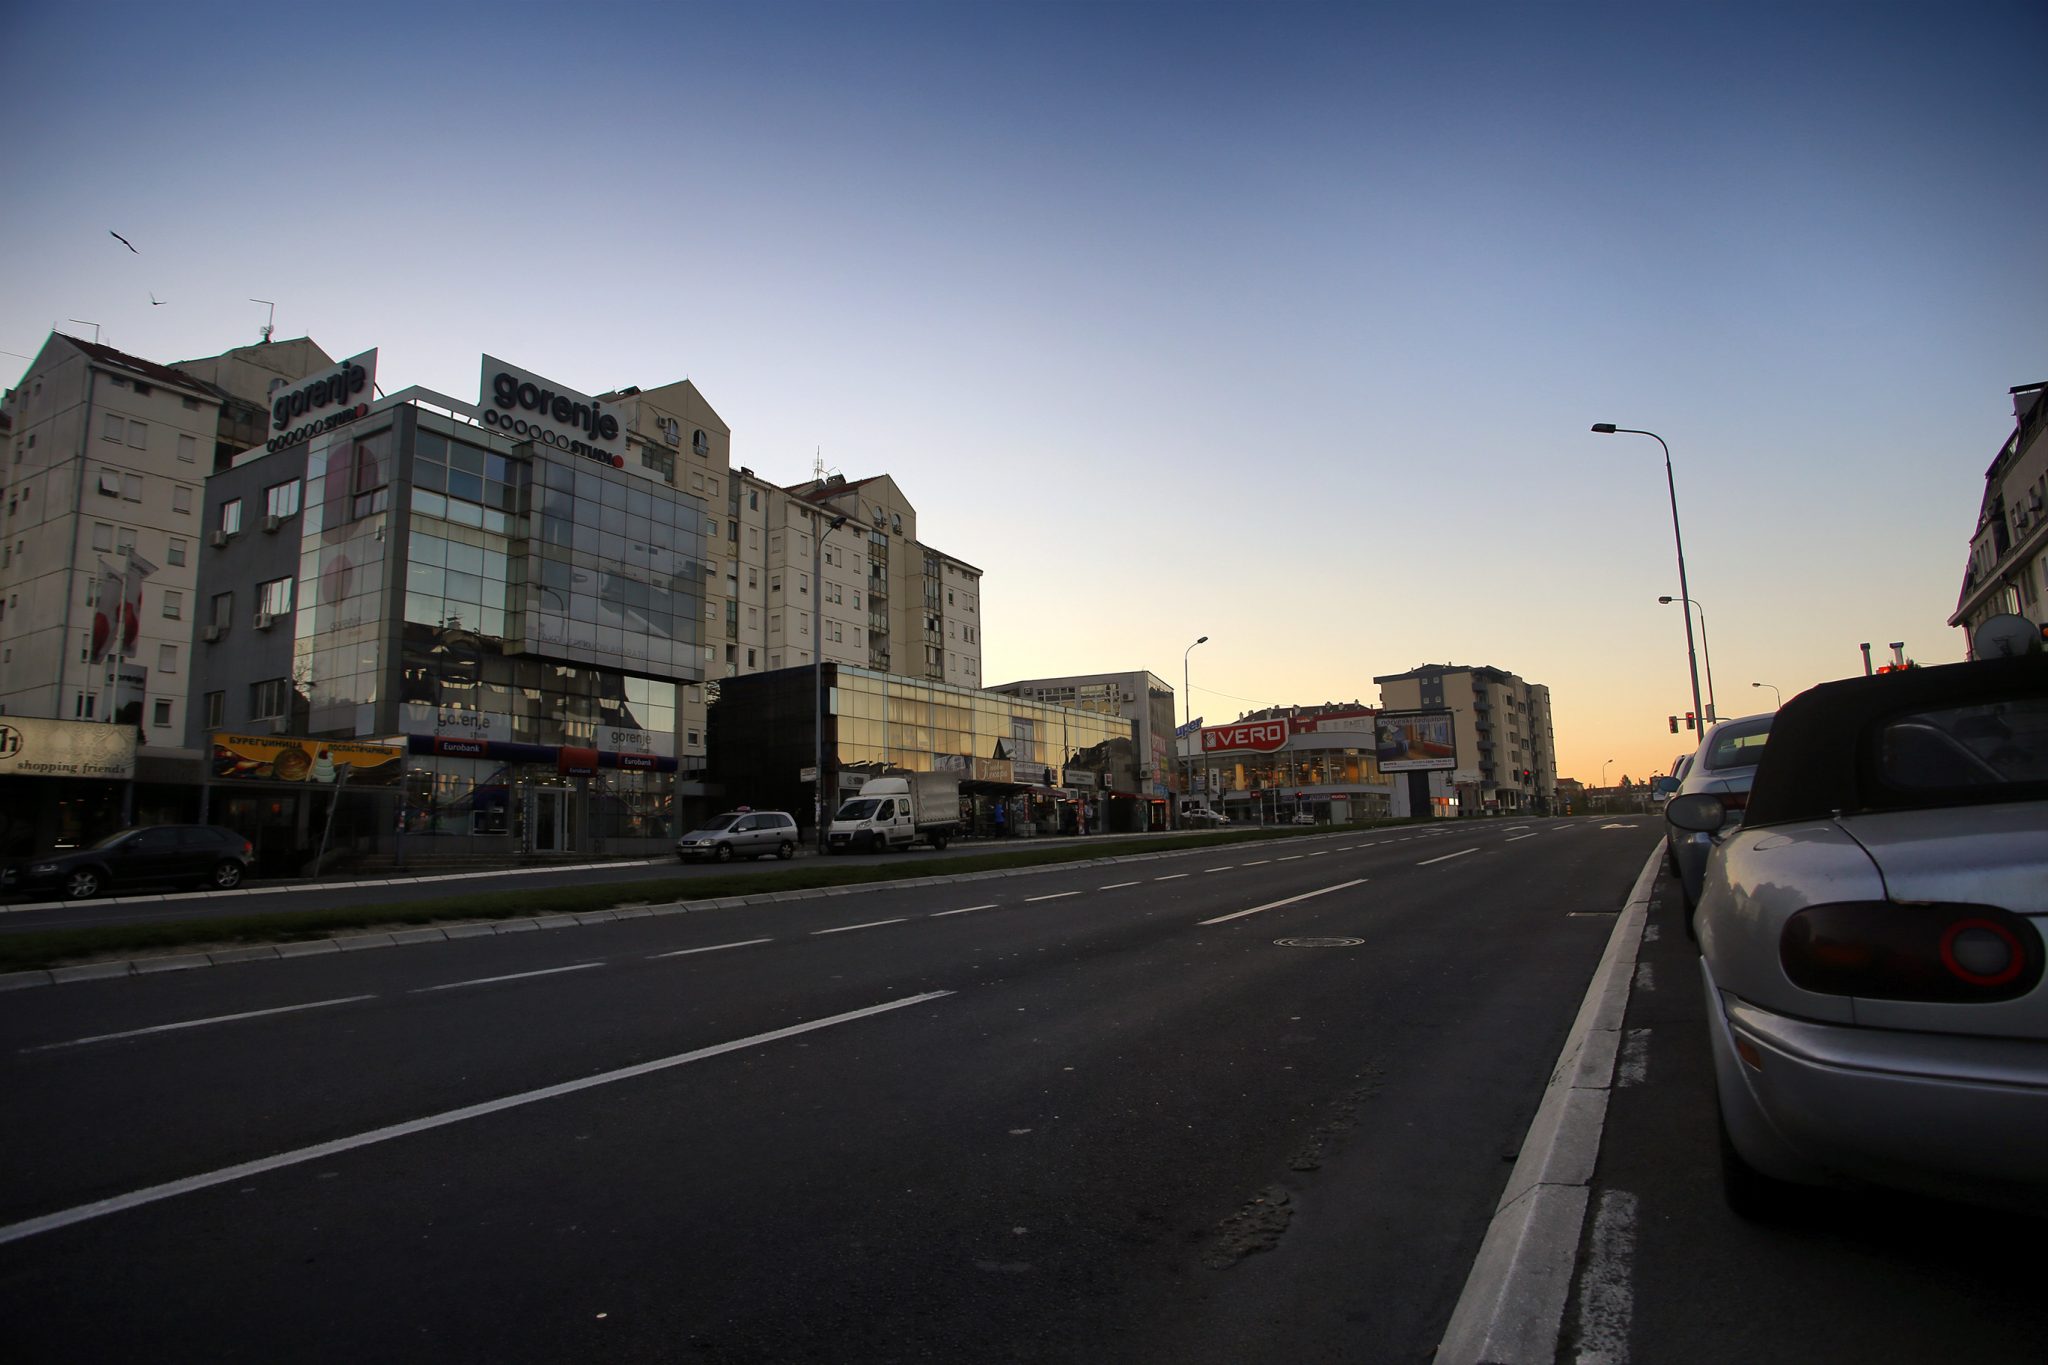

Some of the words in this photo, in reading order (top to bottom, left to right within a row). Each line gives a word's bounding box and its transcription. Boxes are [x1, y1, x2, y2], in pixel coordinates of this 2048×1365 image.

[273, 361, 366, 431] gorenje
[494, 373, 619, 440] gorenje
[1175, 717, 1203, 738] uper
[1218, 725, 1281, 745] VERO
[611, 731, 652, 745] gorenje
[443, 742, 480, 753] Eurobank
[17, 760, 78, 774] shopping
[82, 763, 126, 775] friends
[624, 757, 651, 767] Eurobank
